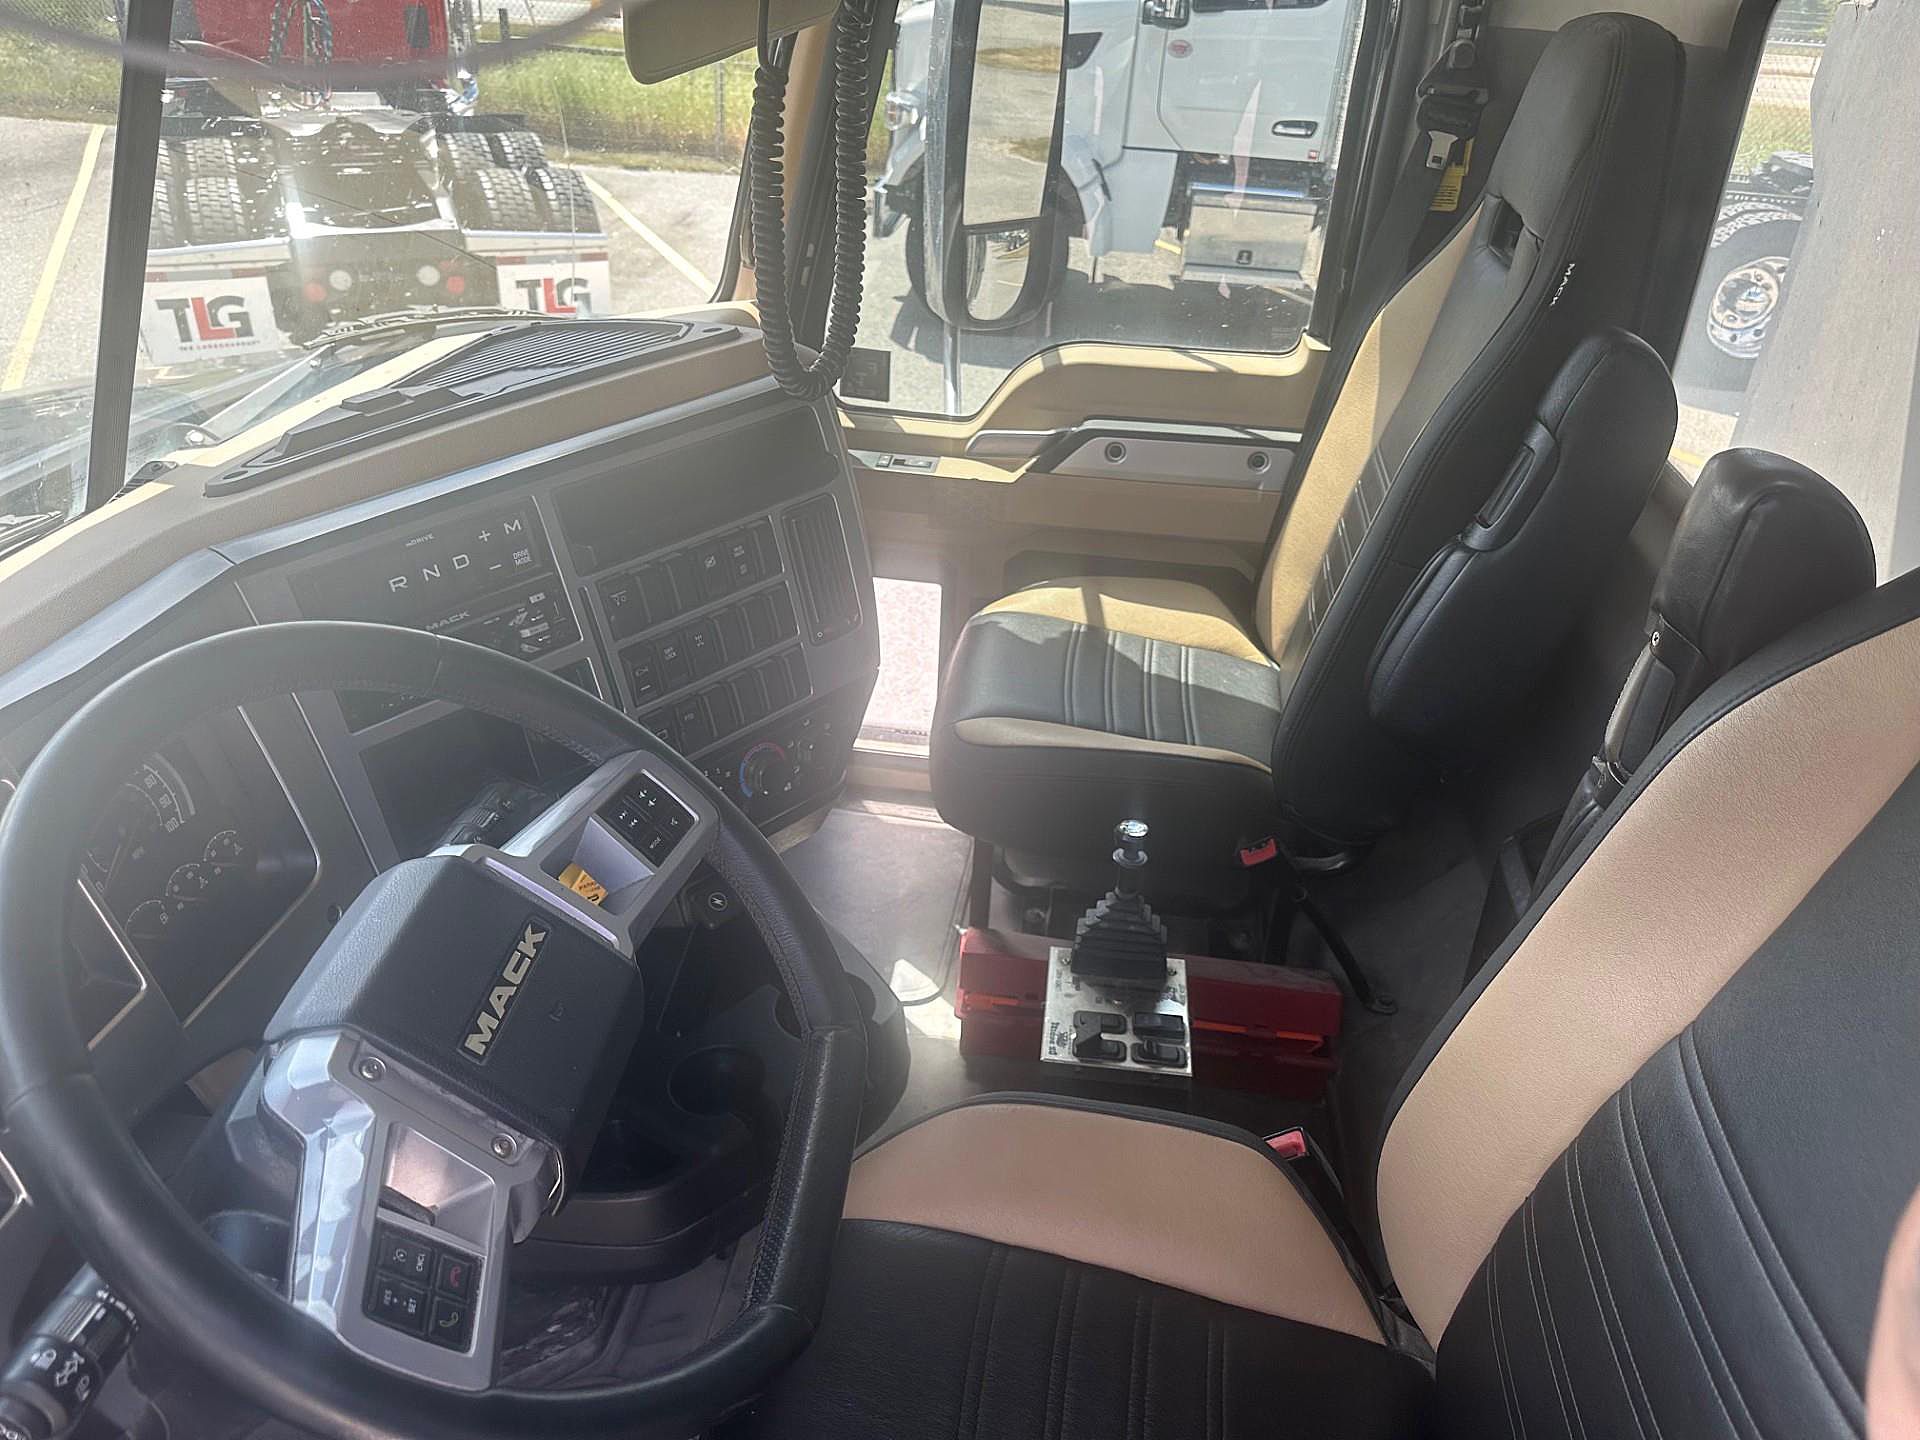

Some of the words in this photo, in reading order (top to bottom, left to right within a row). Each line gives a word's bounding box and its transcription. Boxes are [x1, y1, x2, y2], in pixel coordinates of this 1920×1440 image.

[515, 277, 592, 314] TLG
[1549, 263, 1576, 307] MACK
[155, 295, 255, 342] TLG
[503, 519, 522, 535] M
[388, 575, 408, 592] R
[421, 564, 441, 582] N
[452, 553, 470, 570] D
[464, 923, 547, 1056] MACK
